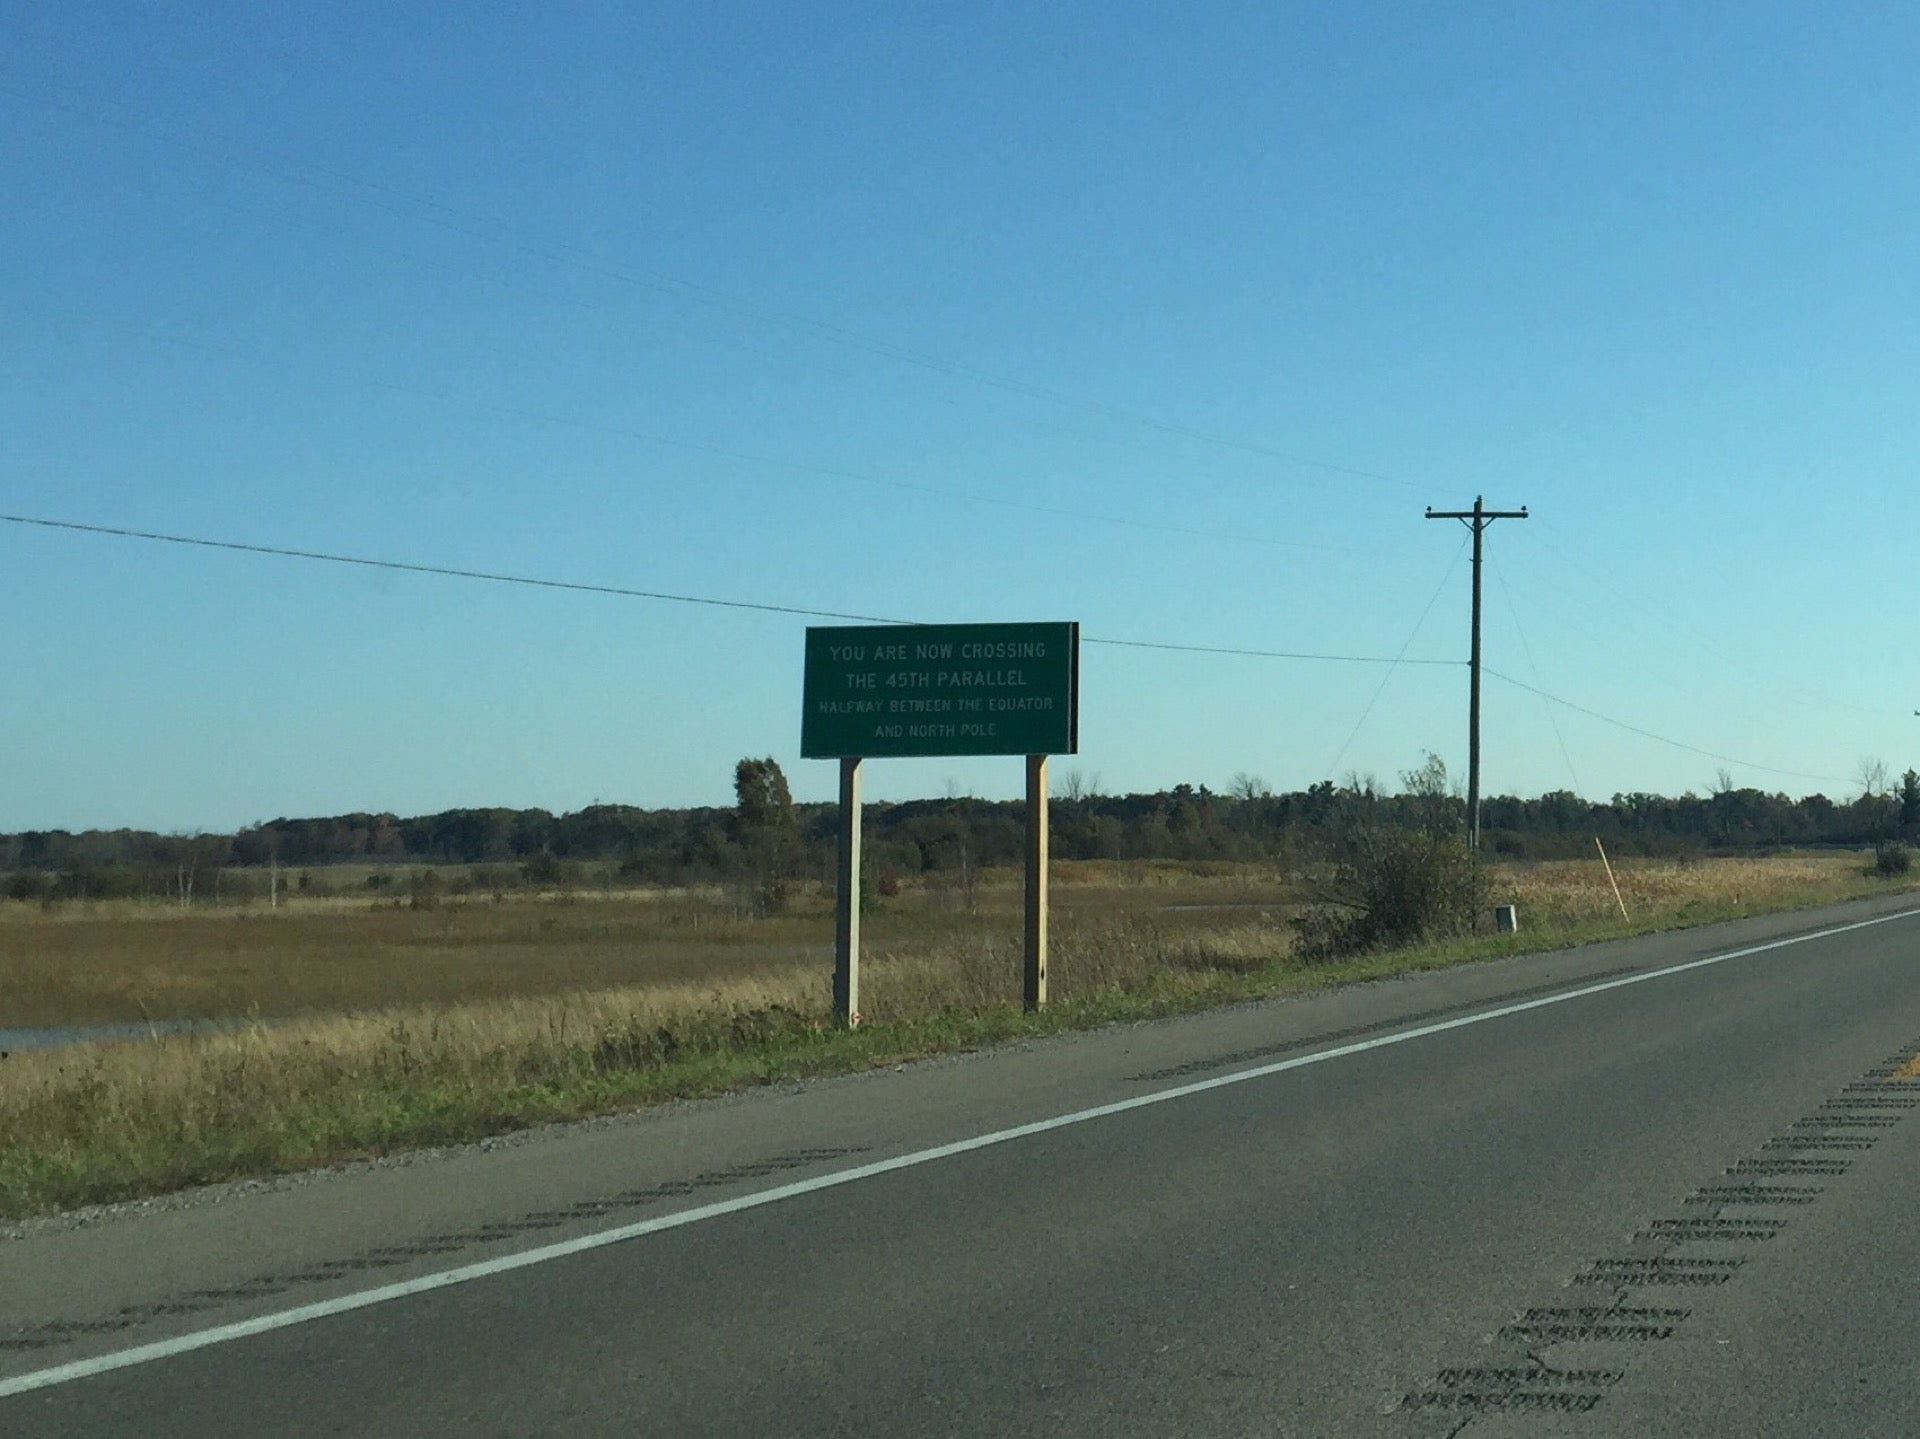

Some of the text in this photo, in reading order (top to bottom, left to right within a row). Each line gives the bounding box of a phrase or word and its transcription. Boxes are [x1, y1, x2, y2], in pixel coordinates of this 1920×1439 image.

[829, 642, 1046, 661] YOU ARE NOW CROSSING
[846, 670, 1027, 689] THE 45TH PARALLEL
[890, 698, 951, 713] BETWEEN
[958, 698, 983, 711] THE
[989, 696, 1053, 711] EQUATOR
[875, 723, 996, 738] AND NORTH POLE
